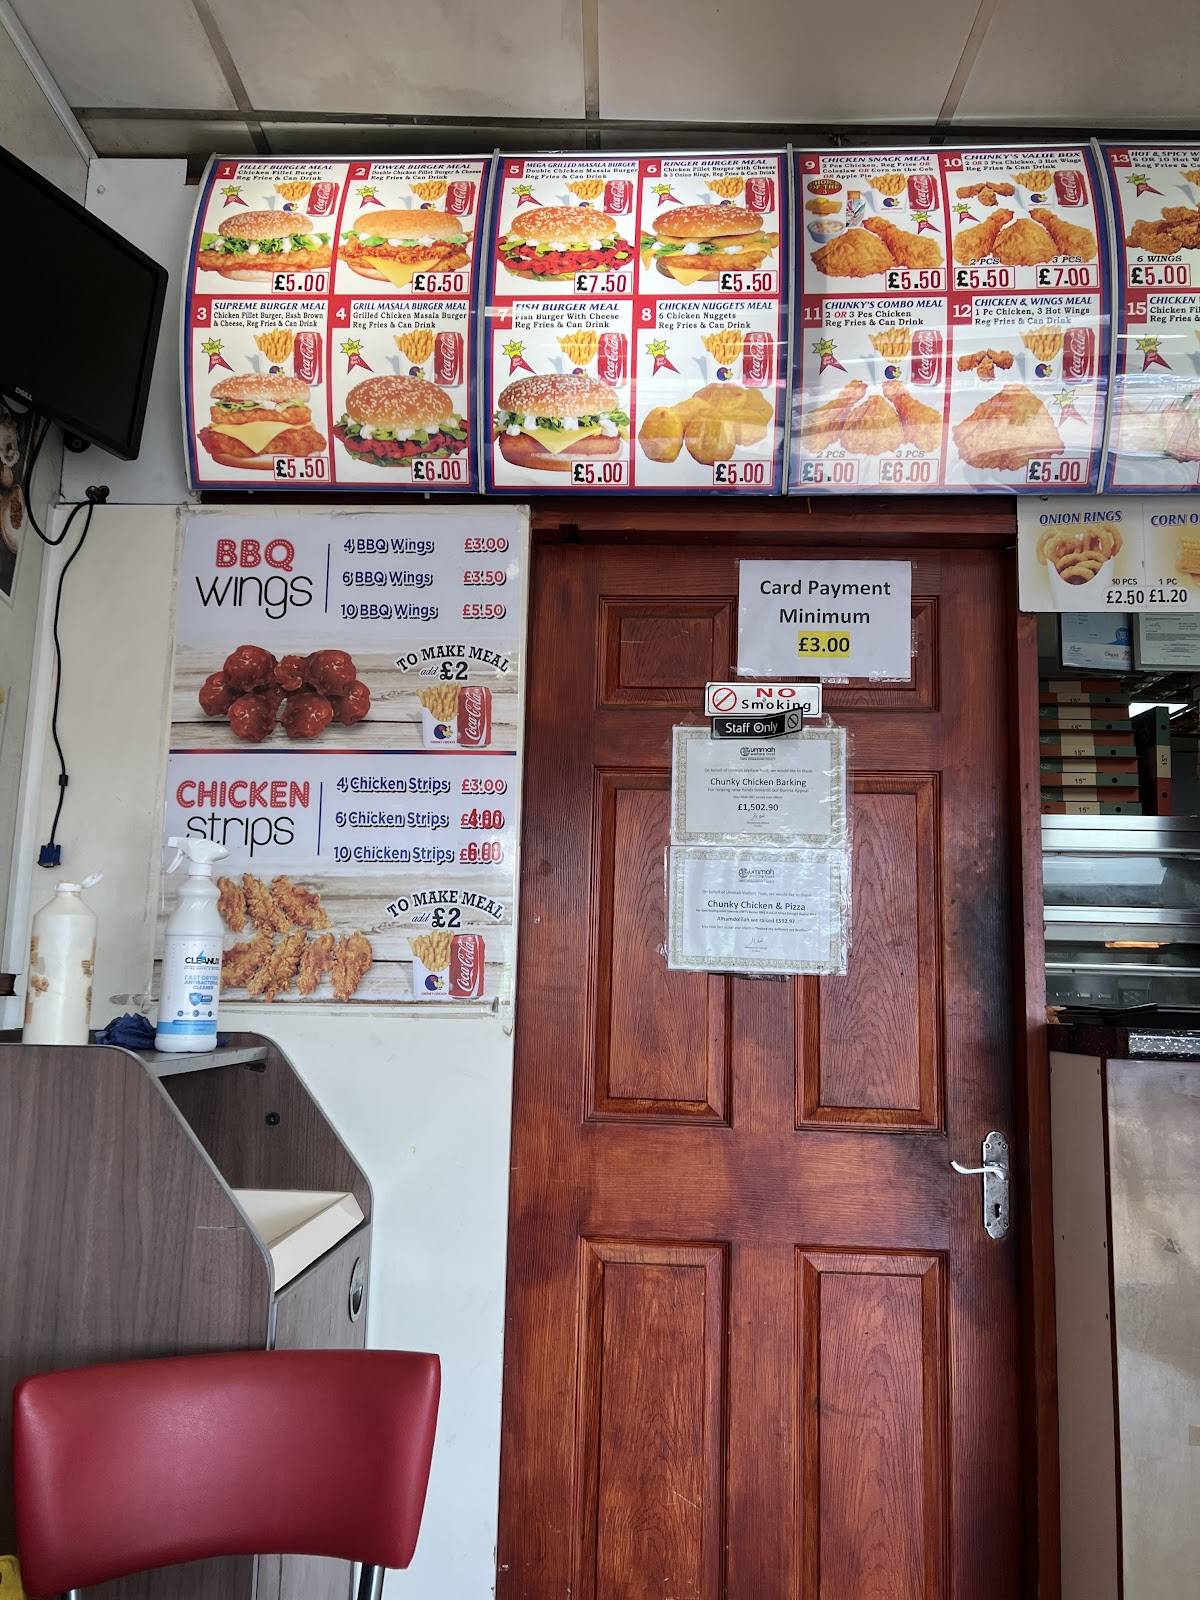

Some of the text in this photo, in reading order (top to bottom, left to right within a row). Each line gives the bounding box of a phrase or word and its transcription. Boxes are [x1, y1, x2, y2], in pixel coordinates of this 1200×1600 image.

[510, 166, 519, 174] 5
[647, 165, 656, 173] 6
[804, 161, 815, 170] 9
[944, 159, 962, 167] 10
[274, 274, 325, 292] £5.00
[414, 274, 463, 292] £6.50
[577, 274, 627, 292] £7.50
[721, 273, 772, 291] £5.50
[888, 271, 941, 289] £5.50
[957, 269, 1009, 288] £5.50
[1039, 268, 1090, 287] £7.00
[1132, 266, 1187, 285] £5.00
[353, 302, 466, 310] GRILL MASALA BURGER MEAL
[515, 303, 619, 311] FISH BURGER MEAL
[659, 302, 773, 310] CHICKEN NUGGETS MEAL
[825, 299, 943, 309] CHUNKY'S COMBO MEAL
[975, 297, 1092, 306] CHICKEN & WINGS MEAL
[1128, 303, 1146, 315] 15
[196, 307, 207, 320] 3
[261, 312, 283, 320] Burger,
[335, 308, 346, 320] 4
[442, 312, 467, 320] Burger
[641, 308, 652, 320] 8
[703, 312, 736, 321] Nuggets
[804, 308, 821, 320] 11
[953, 304, 971, 317] 12
[276, 460, 325, 478] £5.50
[414, 461, 461, 479] £6.00
[574, 463, 622, 483] £5.00
[715, 463, 764, 483] £5.00
[802, 462, 854, 482] £5.00
[881, 462, 931, 481] £6.00
[1029, 461, 1081, 481] £5.00
[1040, 511, 1122, 524] ONION RINGS
[1151, 515, 1187, 525] CORN
[344, 538, 435, 554] 4 BBQ Wings
[464, 538, 509, 552] £3.00
[215, 538, 295, 572] BBQ
[342, 571, 433, 587] 6 BBQ Wings
[463, 571, 507, 585] £3.50
[760, 580, 891, 598] Card Payment
[1149, 589, 1187, 603] £1.20
[195, 576, 313, 619] wings
[1106, 590, 1144, 604] £2.50
[341, 604, 439, 619] 10 BBQ Wings
[462, 603, 506, 618] £5.50
[780, 608, 870, 624] Minimum
[798, 637, 850, 652] £3.00
[396, 645, 510, 673] TO MAKE MEAL
[420, 662, 468, 680] add £2
[756, 688, 796, 697] NO
[742, 699, 811, 712] Smoking
[725, 721, 777, 734] Staff Only
[336, 777, 451, 795] 4 Chicken Strips
[461, 779, 507, 795] £3.00
[710, 778, 806, 787] Chunky Chicken Barking
[176, 780, 310, 808] CHICKEN
[738, 804, 778, 812] £1,502.90
[335, 811, 450, 829] 6 Chicken Strips
[186, 812, 295, 857] strips
[333, 846, 455, 865] 10 Chicken Strips
[387, 890, 503, 918] TO MAKE MEAL
[708, 900, 738, 910] Chunky
[740, 901, 772, 910] Chicken
[776, 902, 782, 910] &
[411, 908, 461, 928] add £2
